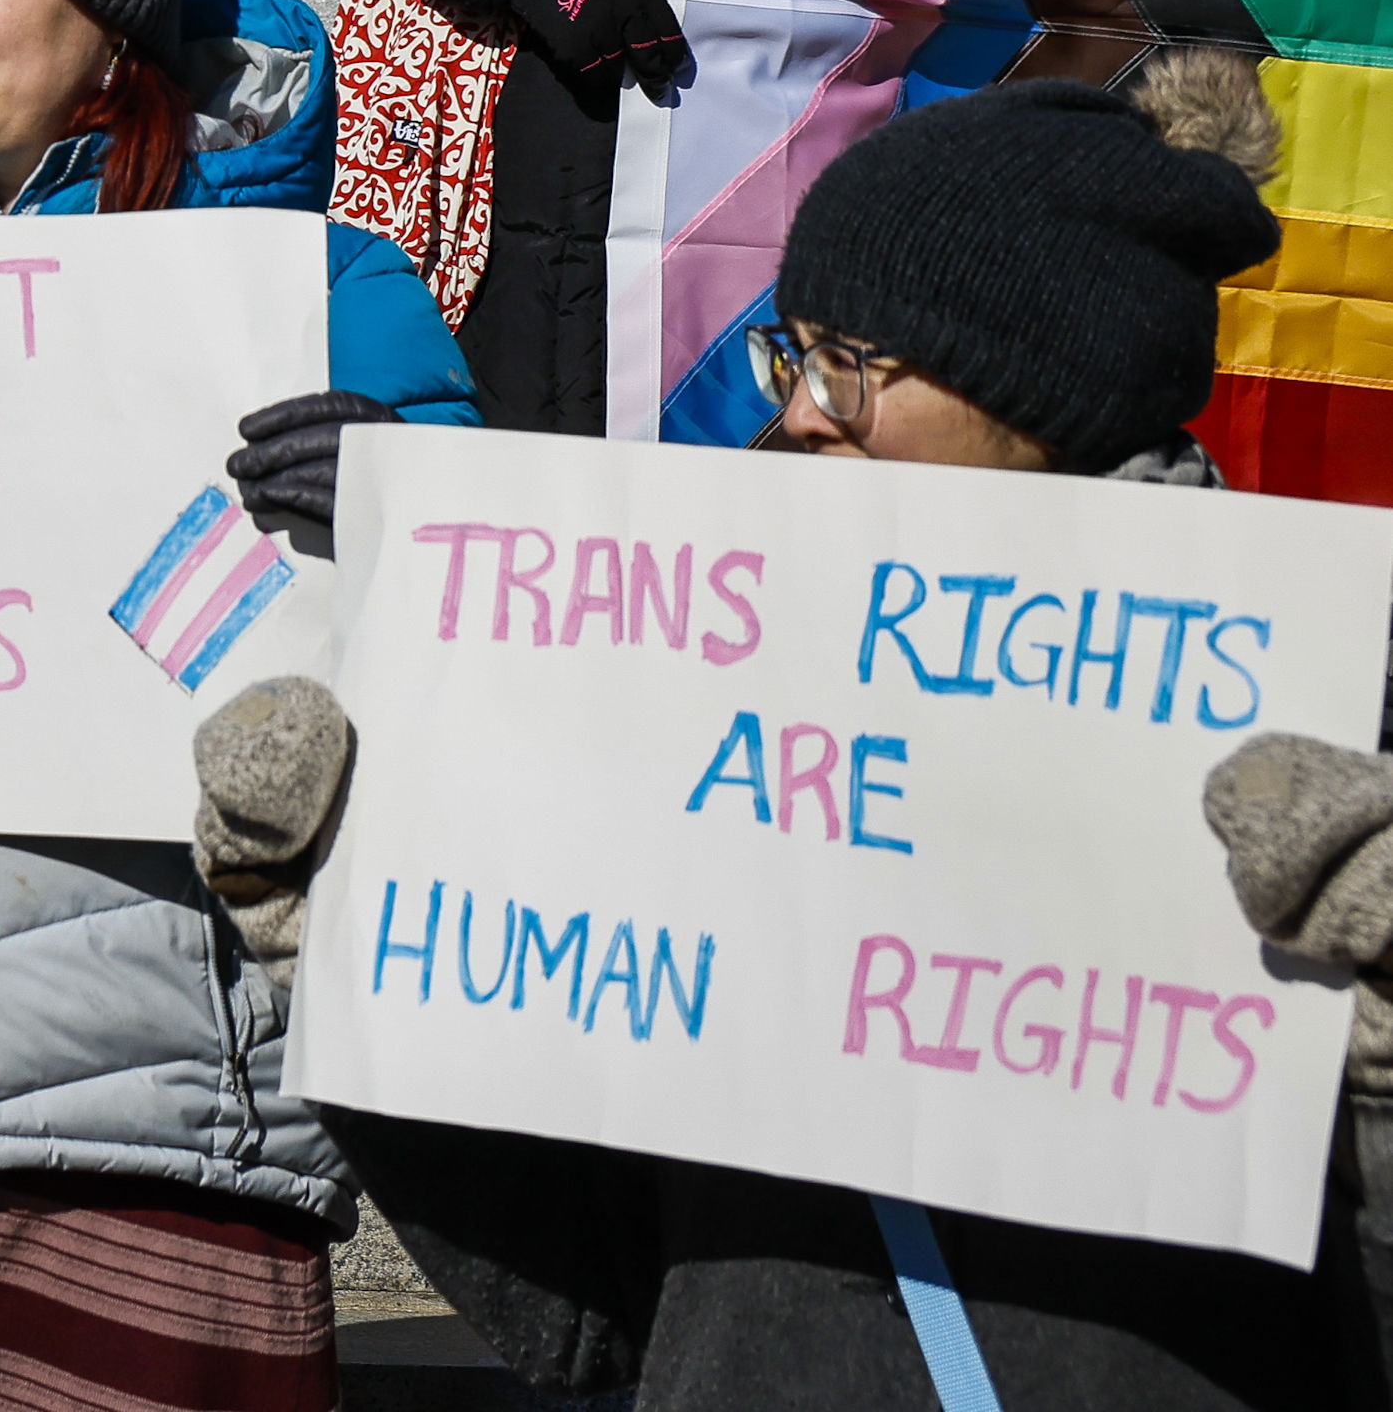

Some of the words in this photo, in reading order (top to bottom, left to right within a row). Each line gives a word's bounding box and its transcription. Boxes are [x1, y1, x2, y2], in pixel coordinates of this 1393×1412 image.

[412, 521, 765, 666] TRANS
[856, 560, 1272, 729] RIGHTS
[685, 710, 915, 856] ARE
[372, 879, 717, 1043] HUMAN
[842, 934, 1275, 1113] RIGHTS
